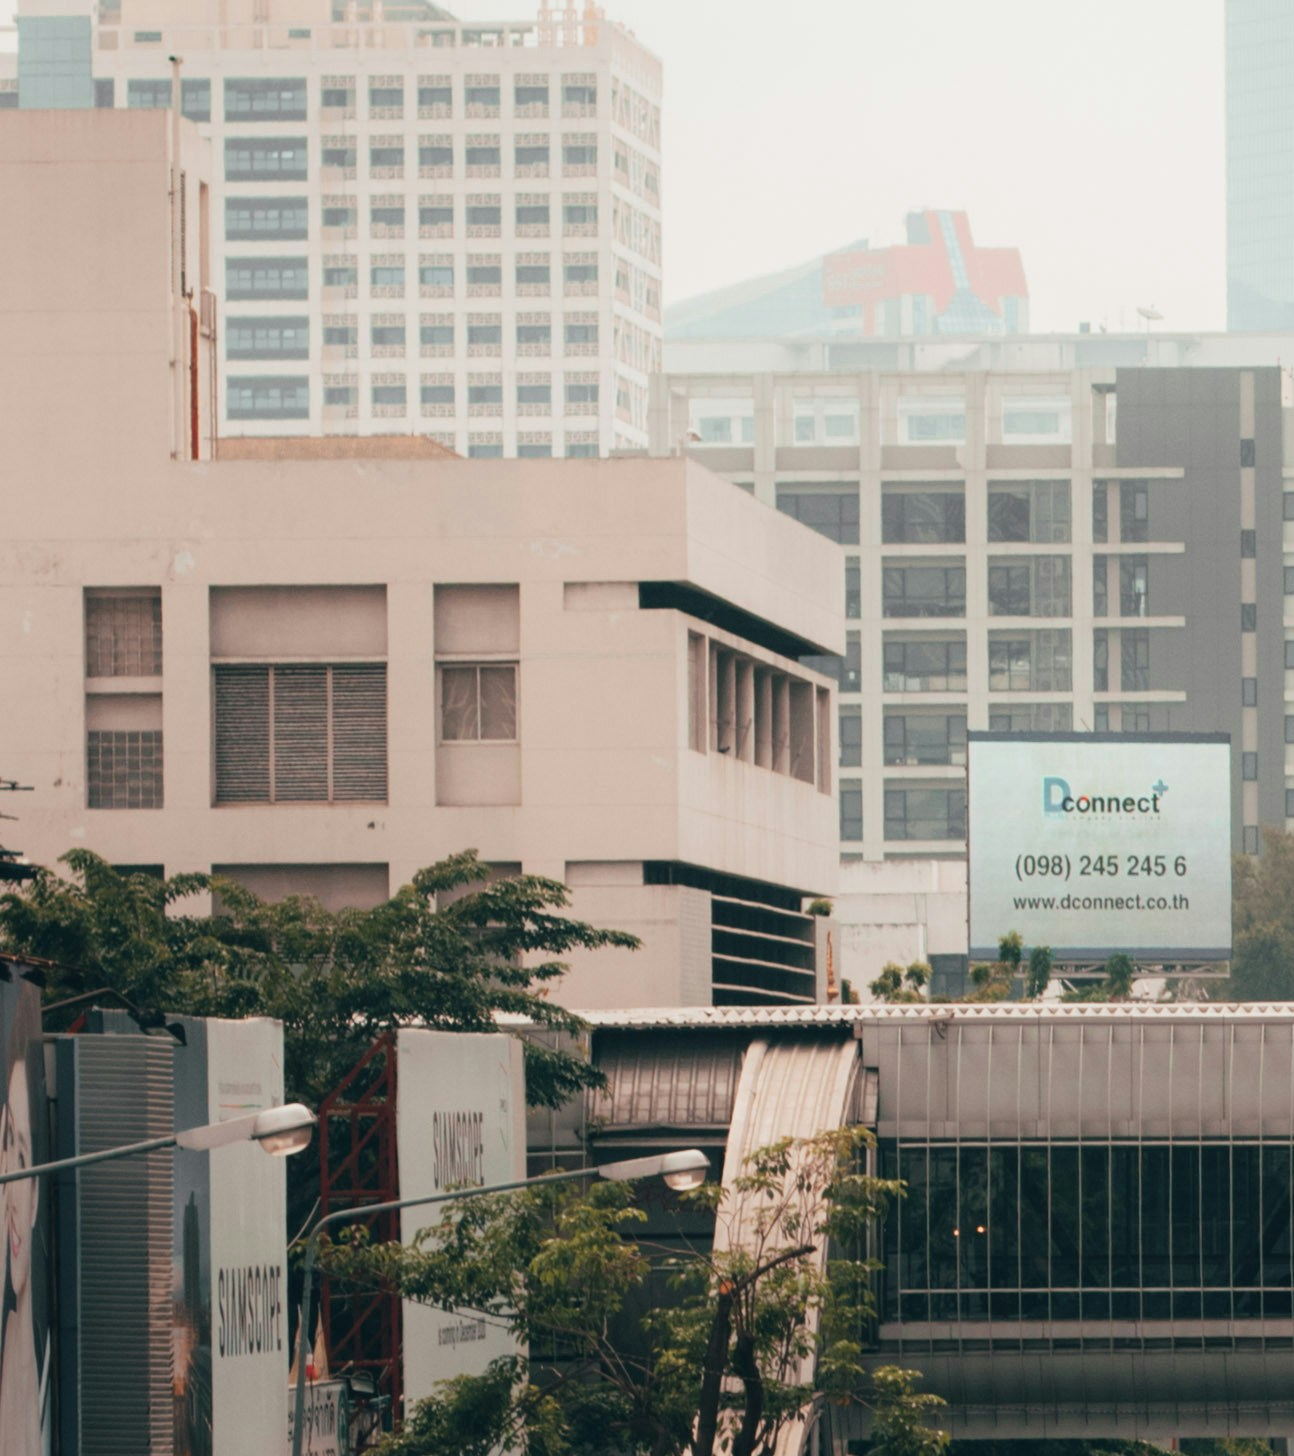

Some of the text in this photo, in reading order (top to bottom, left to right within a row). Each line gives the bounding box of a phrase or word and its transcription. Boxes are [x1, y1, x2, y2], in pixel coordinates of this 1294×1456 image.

[1015, 854, 1186, 881] (098) 245 245 6
[1013, 894, 1189, 911] www.dconnect.co.th
[219, 1266, 282, 1358] SIAMSCAPE
